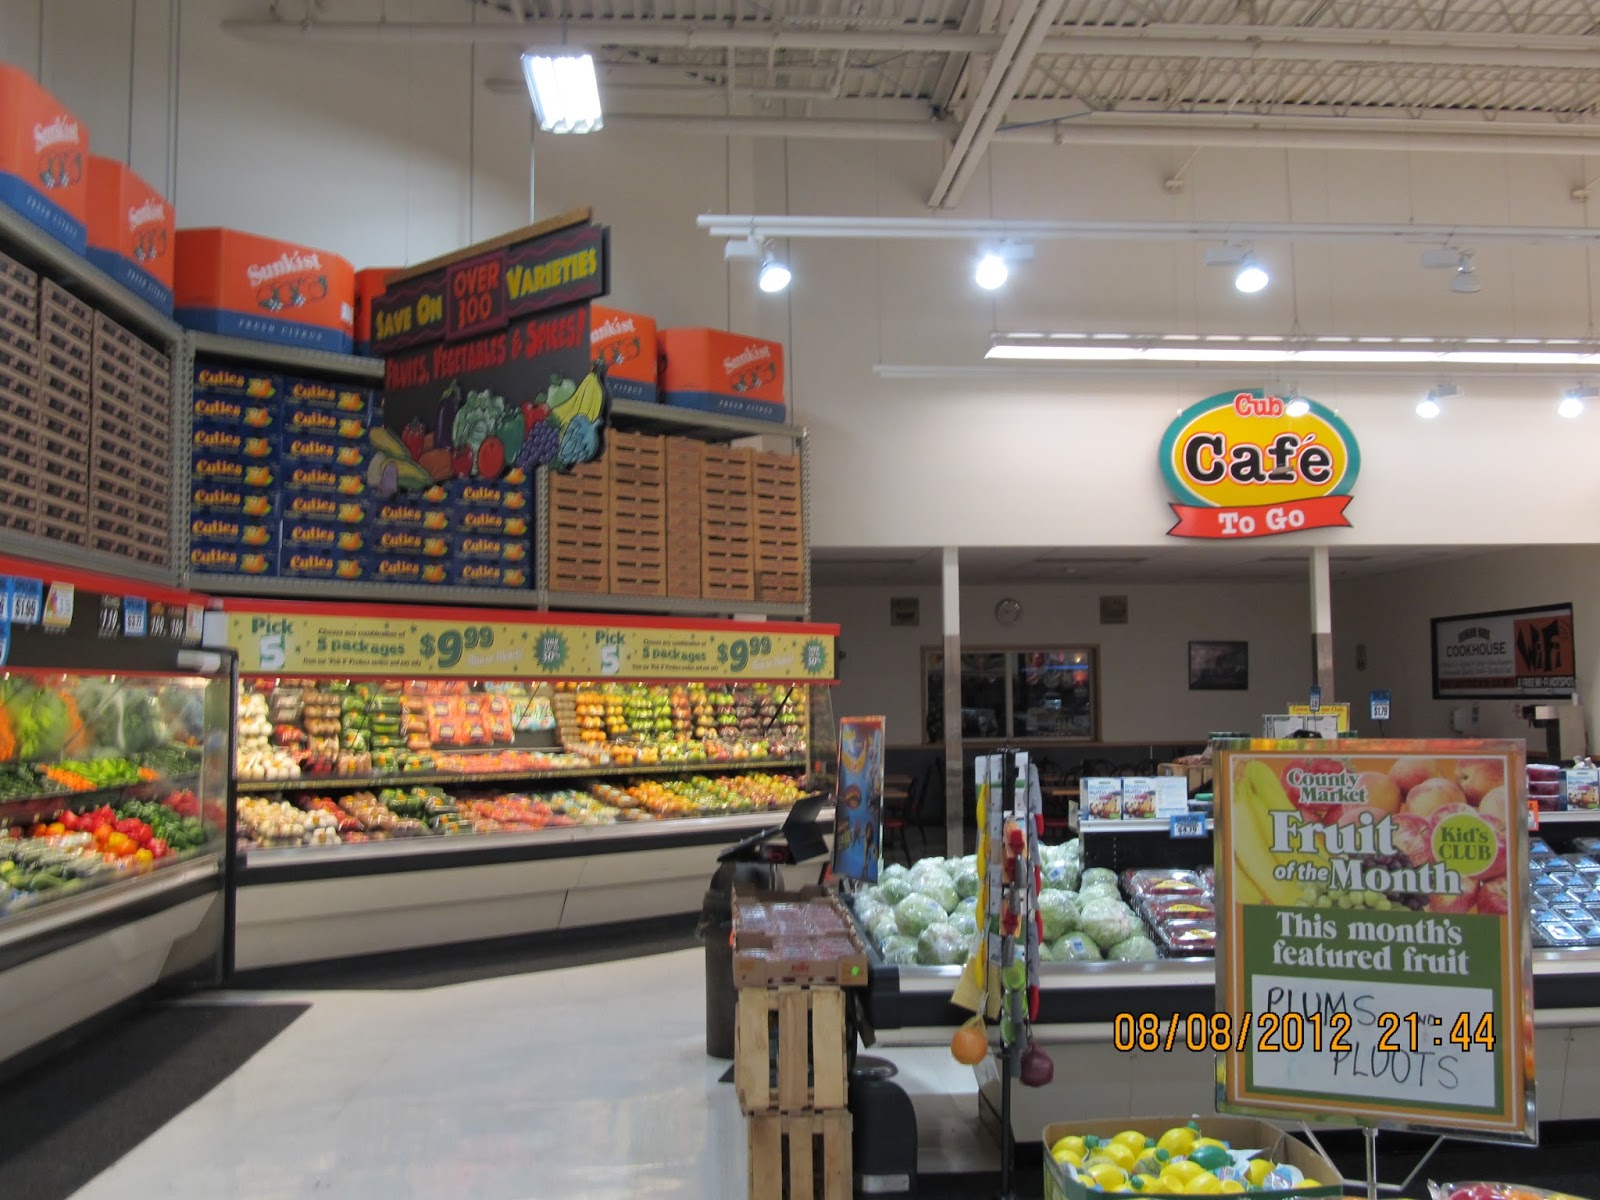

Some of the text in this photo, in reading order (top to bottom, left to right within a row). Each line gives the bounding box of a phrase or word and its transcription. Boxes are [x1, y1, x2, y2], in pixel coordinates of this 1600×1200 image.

[247, 250, 322, 287] Sunkist
[453, 261, 500, 299] OVER
[458, 293, 492, 332] 100
[590, 316, 635, 344] unkist
[199, 369, 245, 388] Cuties
[293, 384, 336, 400] Cuties
[195, 399, 241, 416] Cuties
[1234, 393, 1285, 418] Cub
[293, 412, 336, 428] Cuties
[194, 430, 241, 447] Cuties
[290, 440, 334, 456] Cuties
[1184, 432, 1333, 484] Café
[196, 459, 243, 476] Cuties
[293, 469, 336, 484] Cuties
[194, 489, 242, 505] Cuties
[463, 486, 501, 501] Cuties
[293, 498, 336, 514] Cuties
[381, 505, 421, 520] Cuties
[192, 519, 239, 536] Cuties
[465, 513, 502, 528] Cuties
[1218, 508, 1305, 535] To Go
[292, 527, 335, 543] Cuties
[381, 533, 421, 548] Cuties
[462, 540, 500, 554] Cuties
[190, 549, 237, 565] Cuties
[290, 555, 333, 571] Cuties
[379, 560, 419, 575] Cuties
[462, 565, 500, 579] Cuties
[251, 615, 293, 635] Pick
[595, 628, 625, 646] Pick
[259, 634, 286, 670] 5
[331, 639, 405, 657] packages
[653, 649, 706, 663] packages
[1447, 641, 1506, 657] COOKHOUSE
[601, 644, 620, 675] 5
[1287, 768, 1360, 789] County
[1300, 783, 1368, 804] Market
[1269, 810, 1401, 855] Fruit
[1441, 826, 1489, 844] Kid's
[1438, 844, 1492, 861] CLUB
[1273, 858, 1462, 894] of the Month
[1276, 911, 1462, 946] This month's
[1272, 940, 1469, 976] featured fruit
[1266, 986, 1376, 1027] PLUMS
